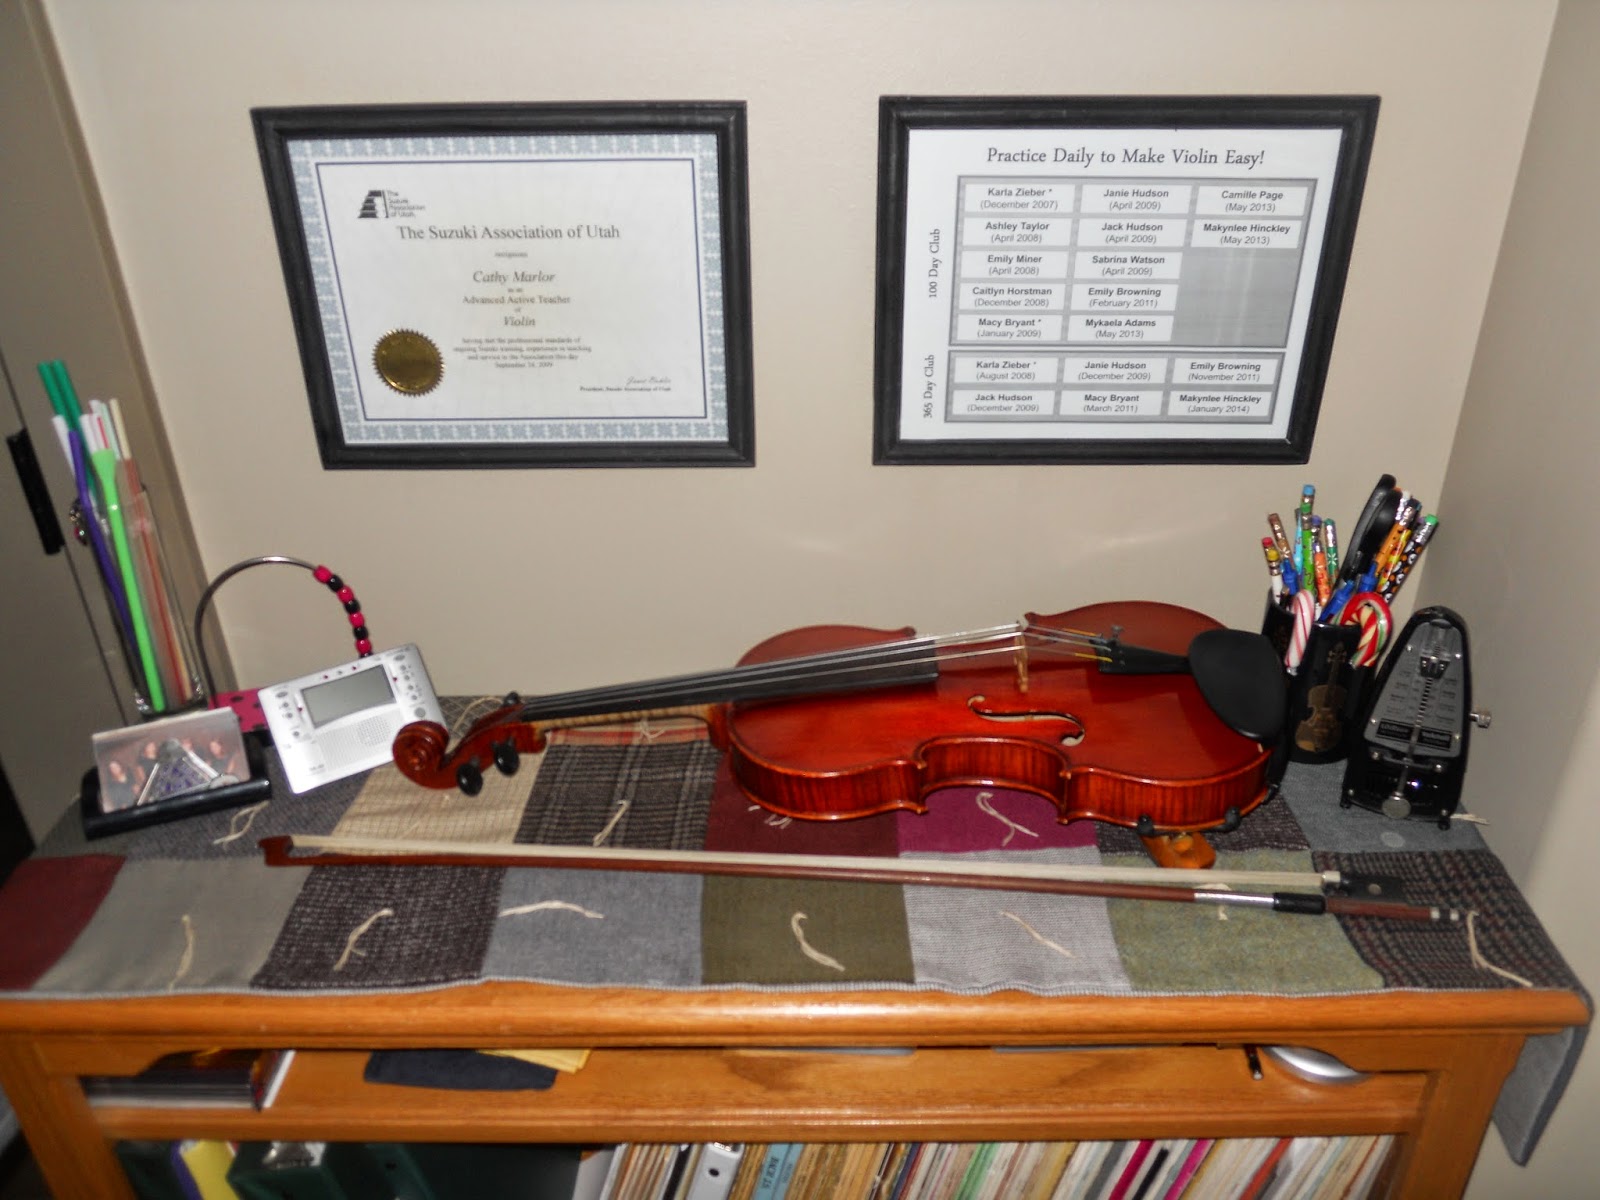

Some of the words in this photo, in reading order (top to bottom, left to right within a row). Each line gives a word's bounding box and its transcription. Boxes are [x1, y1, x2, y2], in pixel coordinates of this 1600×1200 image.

[987, 147, 1046, 163] Practice
[1053, 146, 1094, 168] Daily
[1100, 150, 1116, 163] to
[1122, 148, 1165, 164] Make
[1172, 148, 1218, 164] Violin
[1224, 149, 1265, 170] Easy!
[988, 188, 1013, 197] Karla
[1016, 188, 1046, 197] Zieber
[1104, 188, 1129, 198] Janie
[1132, 188, 1169, 198] Hudson
[1222, 190, 1256, 200] Camille
[1259, 190, 1284, 200] Page
[980, 200, 1030, 210] (December
[1032, 200, 1058, 210] 2007)
[1109, 201, 1132, 211] (April
[1136, 201, 1161, 211] 2009)
[1225, 202, 1247, 212] (May
[1250, 202, 1276, 212] 2013)
[396, 225, 424, 240] The
[429, 224, 477, 240] Suzuki
[482, 225, 563, 240] Association
[568, 224, 582, 239] of
[587, 224, 620, 240] Utah
[986, 222, 1018, 232] Ashley
[1021, 222, 1050, 232] Taylor
[1102, 222, 1124, 232] Jack
[1126, 222, 1163, 232] Hudson
[1204, 224, 1248, 234] Makynlee
[1250, 224, 1290, 234] Hinckley
[929, 228, 940, 254] Club
[990, 234, 1014, 244] (April
[1017, 234, 1042, 244] 2008)
[1105, 234, 1128, 244] (April
[1131, 234, 1156, 244] 2009)
[1220, 236, 1242, 245] (May
[1244, 236, 1270, 245] 2013)
[988, 254, 1014, 264] Emily
[1016, 254, 1042, 264] Miner
[1092, 256, 1128, 264] Sabrina
[1130, 256, 1165, 264] Watson
[928, 257, 942, 278] Day
[988, 266, 1012, 276] (April
[1014, 266, 1040, 276] 2008)
[1102, 267, 1126, 276] (April
[1128, 267, 1152, 276] 2009)
[472, 270, 508, 286] Cathy
[513, 270, 556, 282] Marlor
[929, 281, 937, 298] 100
[972, 287, 1004, 296] Caitlyn
[1007, 287, 1052, 296] Horstman
[1088, 288, 1114, 297] Emily
[1117, 288, 1161, 297] Browning
[463, 296, 504, 304] Advanced
[507, 296, 535, 304] Active
[538, 295, 570, 304] Teacher
[974, 298, 1022, 308] (December
[1024, 298, 1049, 308] 2008)
[1089, 299, 1131, 308] (February
[1134, 299, 1158, 308] 2011)
[504, 316, 536, 326] Violin
[978, 318, 1002, 328] Macy
[1005, 318, 1035, 328] Bryant
[1086, 319, 1122, 328] Mykaela
[1125, 319, 1156, 328] Adams
[977, 330, 1014, 339] (January
[1016, 330, 1042, 339] 2009)
[1096, 330, 1117, 339] (May
[1119, 330, 1144, 339] 2013)
[924, 354, 934, 378] Club
[976, 361, 1000, 369] Karla
[1002, 361, 1030, 369] Zieber
[1085, 362, 1109, 370] Janie
[1112, 362, 1146, 370] Hudson
[1190, 362, 1216, 371] Emily
[1218, 362, 1261, 371] Browning
[976, 372, 1008, 381] (August
[1011, 372, 1036, 381] 2008)
[1078, 372, 1124, 381] (December
[1127, 372, 1151, 381] 2009)
[1188, 373, 1234, 382] (November
[1236, 373, 1260, 382] 2011)
[924, 380, 936, 400] Day
[975, 394, 995, 402] Jack
[998, 394, 1032, 402] Hudson
[1084, 394, 1108, 402] Macy
[1110, 394, 1139, 402] Bryant
[1180, 394, 1220, 404] Makynlee
[1224, 394, 1261, 404] Hinckley
[924, 402, 932, 418] 365
[967, 404, 1012, 412] (December
[1016, 404, 1039, 412] 2009)
[1084, 405, 1112, 413] (March
[1114, 405, 1138, 413] 2011)
[1188, 405, 1223, 414] (January
[1226, 405, 1250, 414] 2014)
